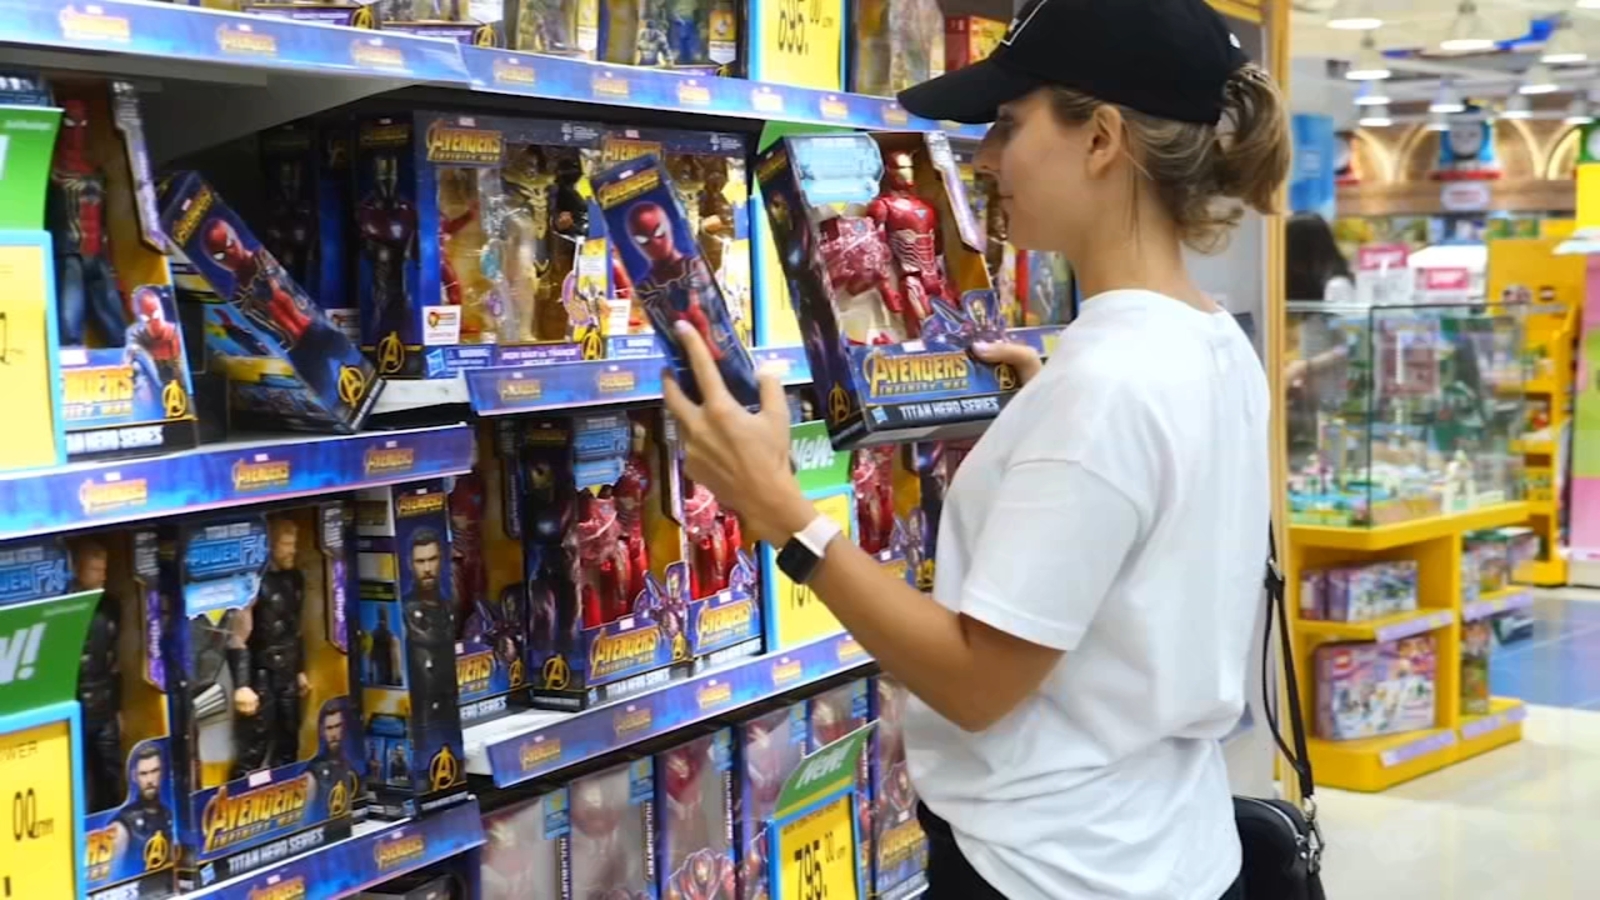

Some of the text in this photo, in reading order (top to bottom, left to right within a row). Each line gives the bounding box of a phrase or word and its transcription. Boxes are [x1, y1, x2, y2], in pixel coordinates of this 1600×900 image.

[427, 120, 503, 158] AVENGERS
[863, 349, 968, 397] AVENGERS
[900, 397, 1001, 421] TITAN HERO SERIES
[590, 628, 661, 680] AVENGERS
[203, 776, 308, 851] AVENGERS
[228, 828, 325, 873] TITAN HERO SERIES
